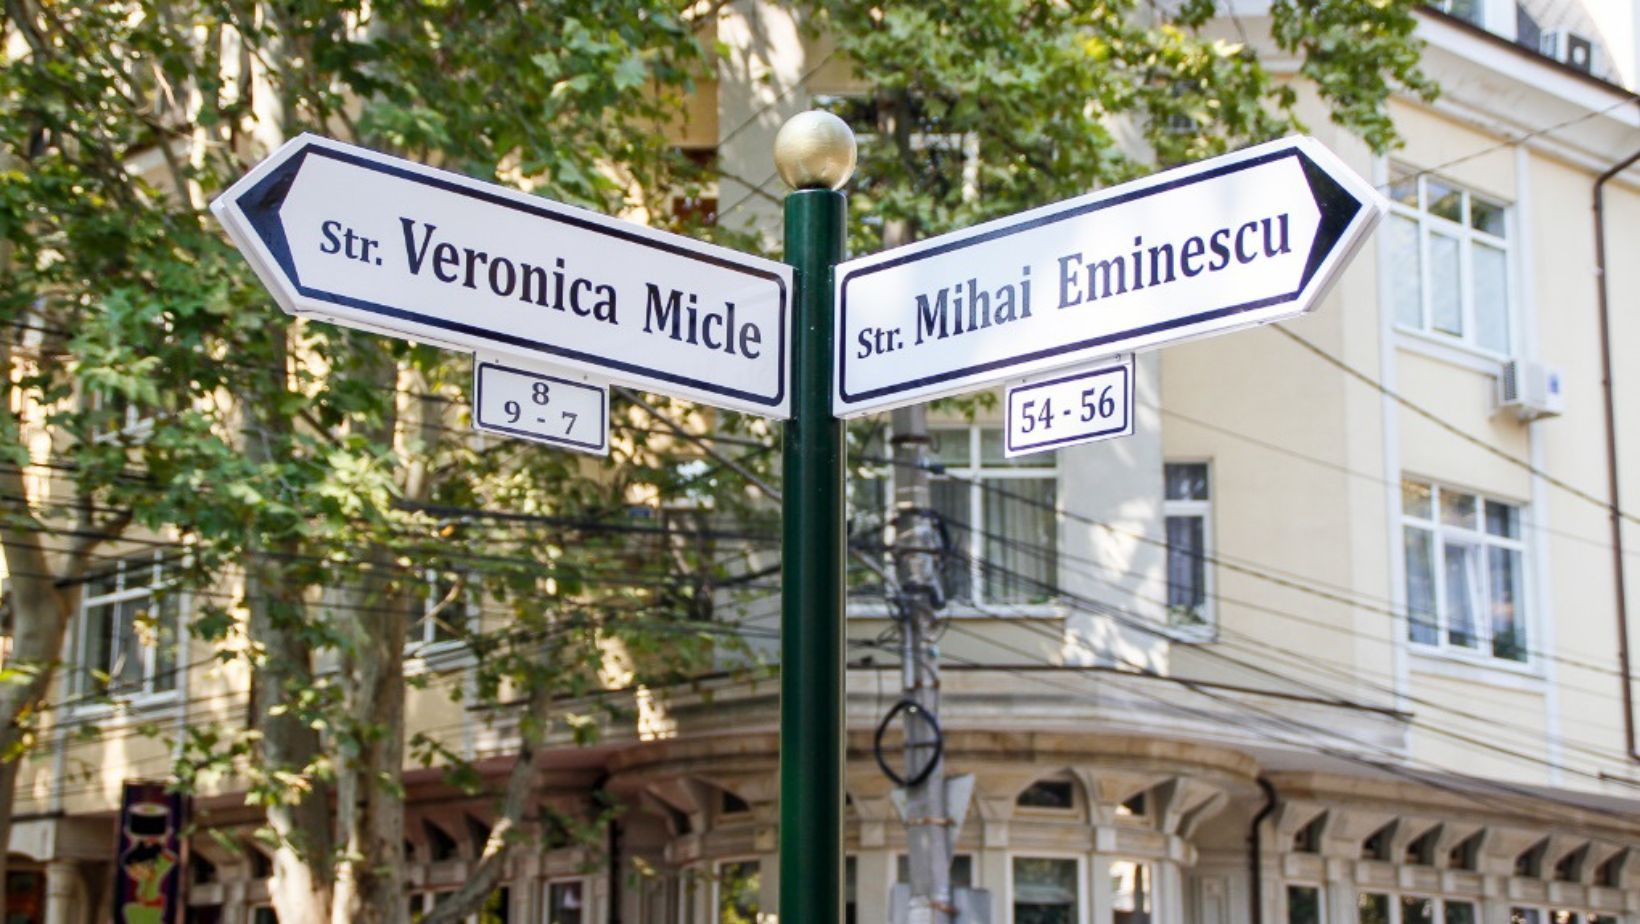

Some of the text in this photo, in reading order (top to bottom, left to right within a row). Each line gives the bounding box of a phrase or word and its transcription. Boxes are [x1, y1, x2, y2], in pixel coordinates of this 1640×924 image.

[319, 216, 763, 360] Str. Veronica Micle
[857, 212, 1293, 360] Str. Mihai Eminescu
[503, 399, 522, 424] 9
[561, 410, 578, 435] 7
[531, 381, 550, 406] 8
[1021, 397, 1054, 434] 54
[1080, 384, 1115, 422] 56
